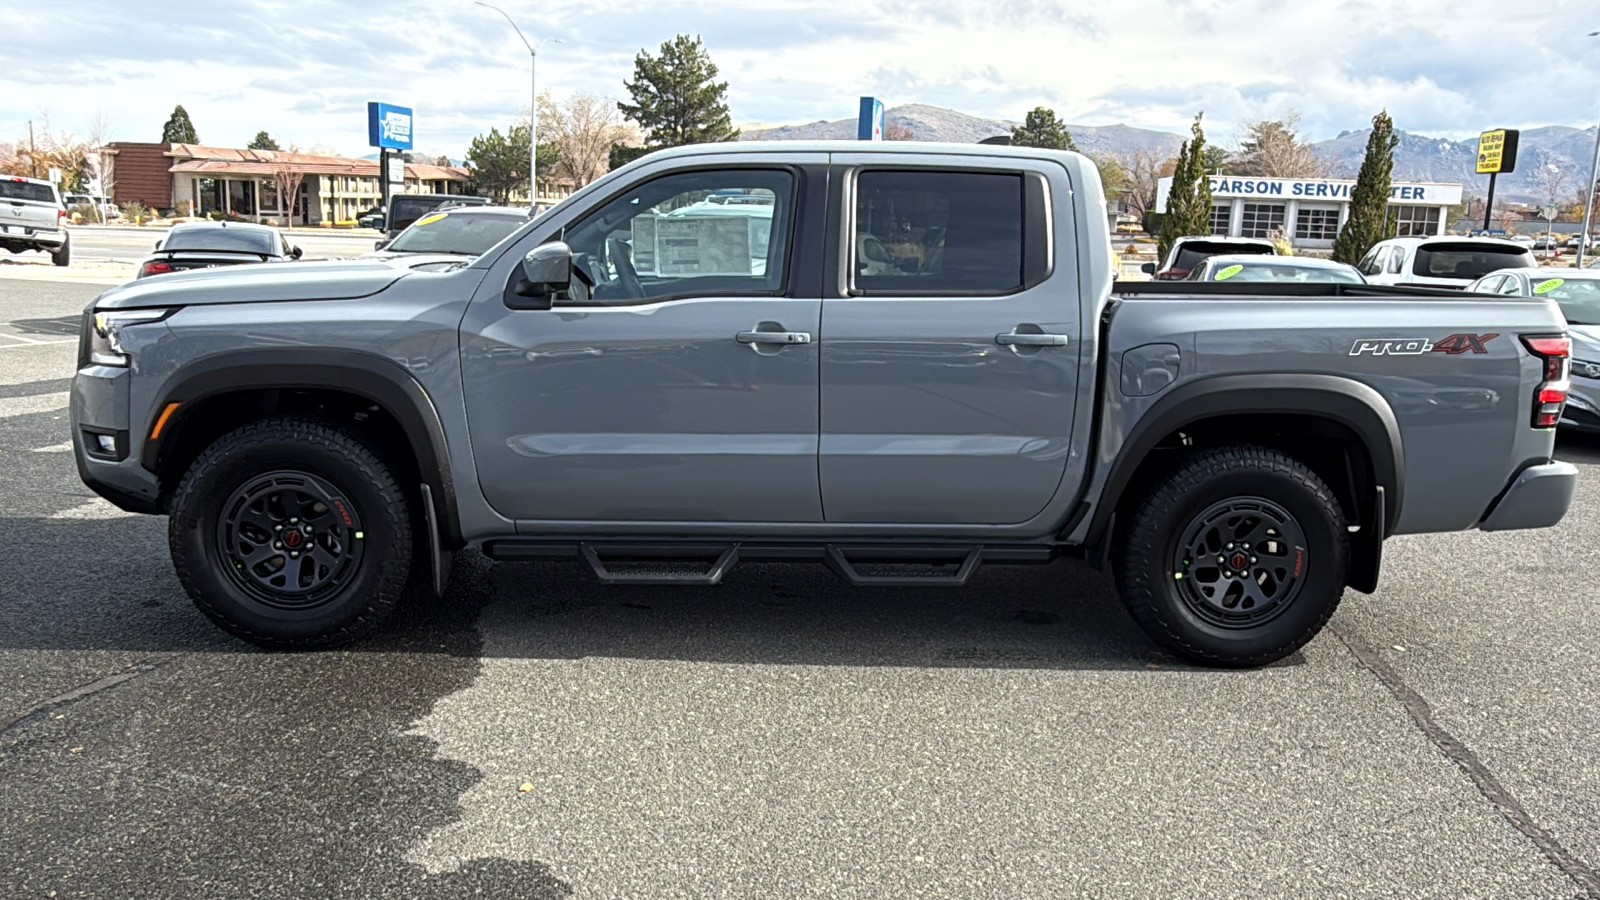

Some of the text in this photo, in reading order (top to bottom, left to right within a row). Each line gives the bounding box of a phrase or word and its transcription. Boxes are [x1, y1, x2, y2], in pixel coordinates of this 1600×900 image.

[1209, 179, 1425, 200] CARSON SERVIC TER
